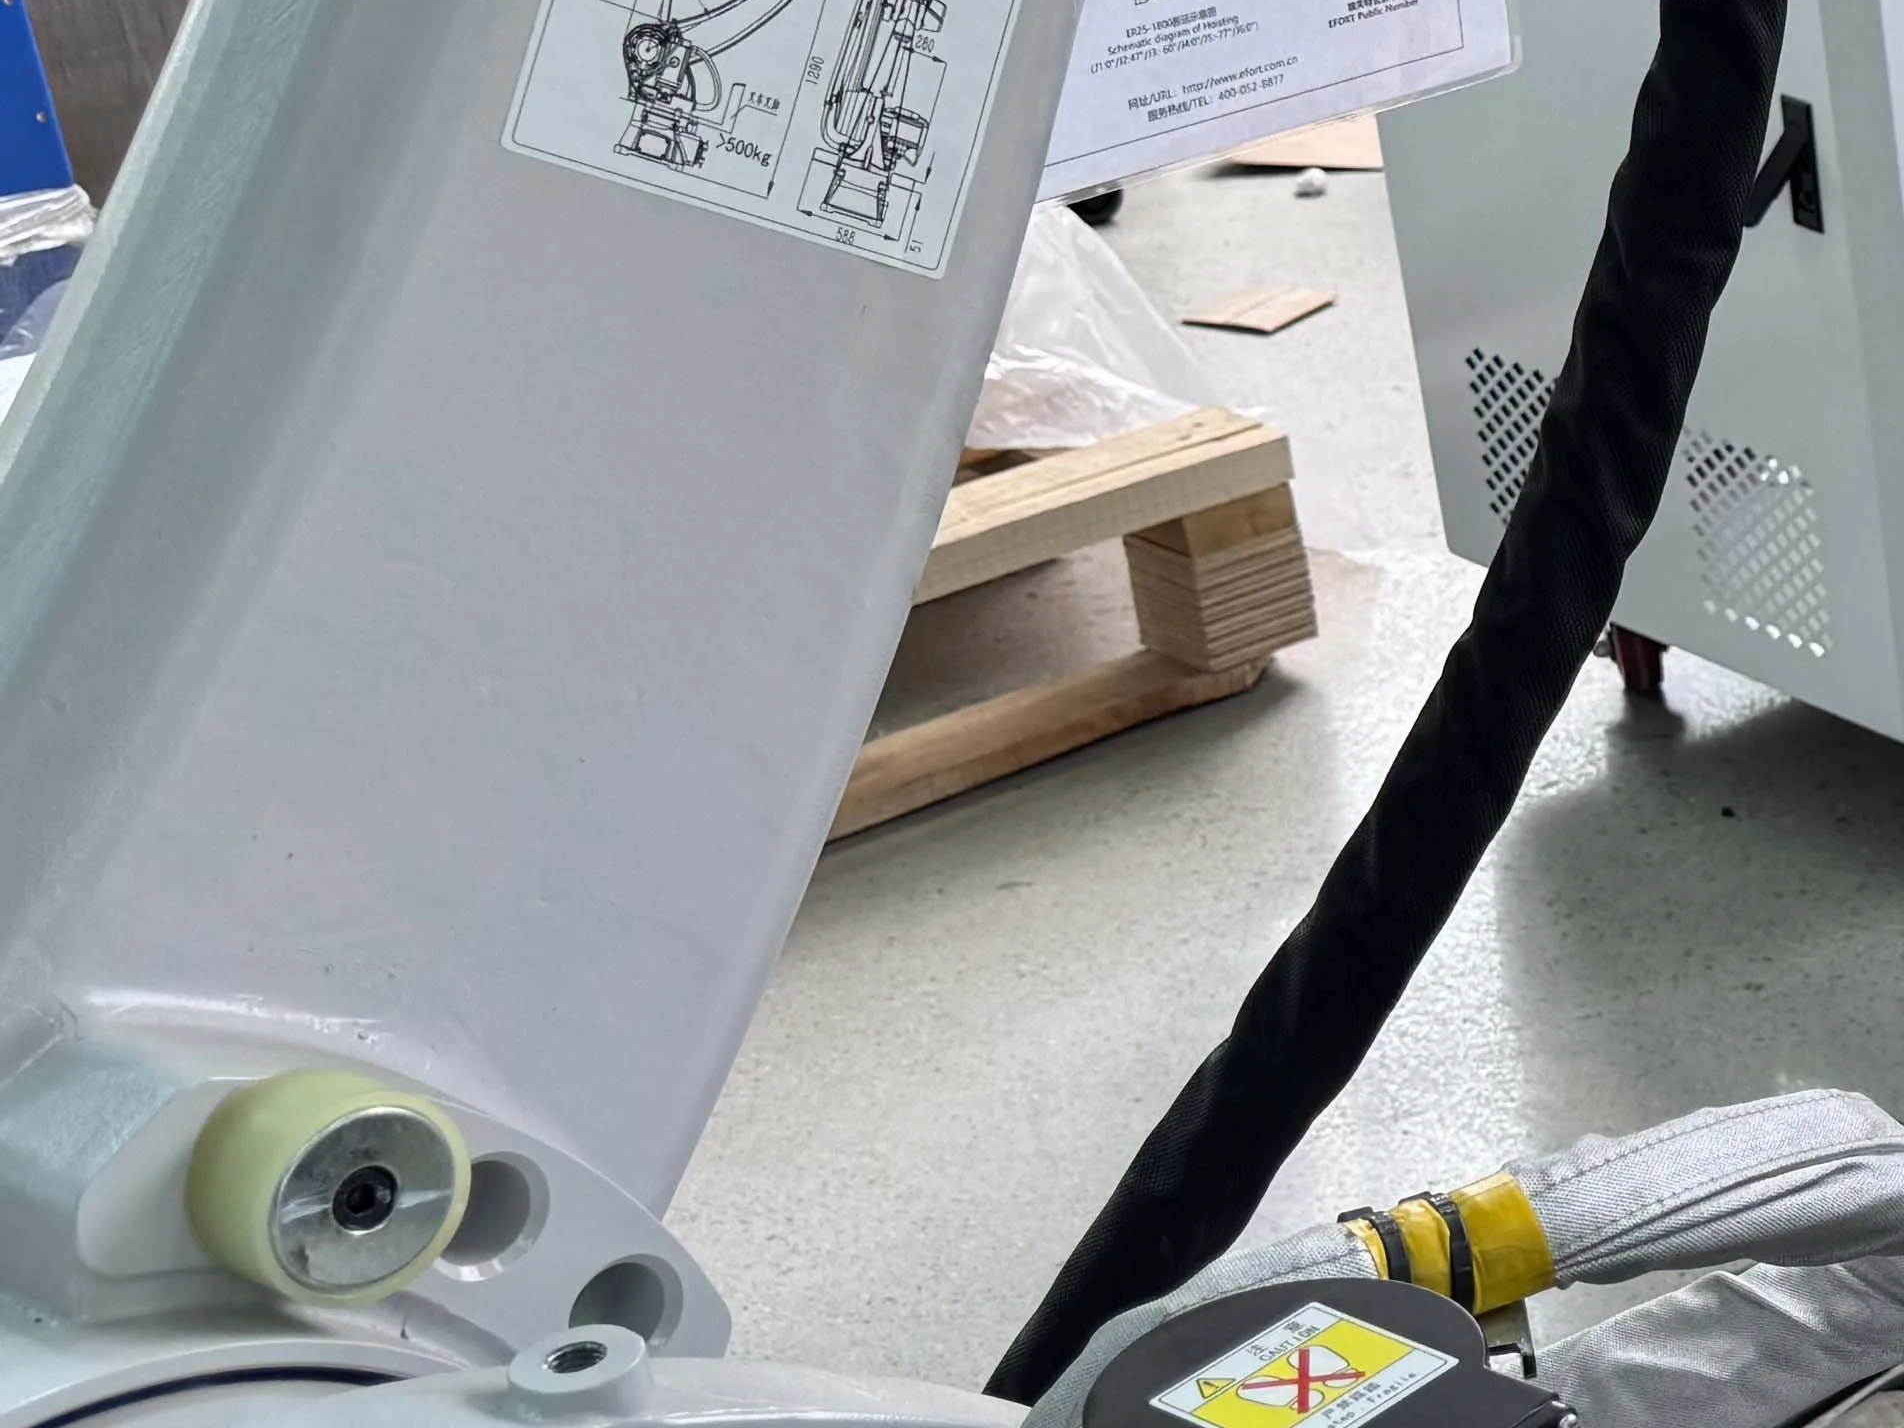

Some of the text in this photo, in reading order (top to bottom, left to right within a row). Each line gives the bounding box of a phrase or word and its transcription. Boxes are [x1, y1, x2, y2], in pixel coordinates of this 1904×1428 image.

[1108, 37, 1152, 55] Schematic
[1155, 28, 1191, 45] diagram
[1192, 25, 1201, 36] of
[806, 56, 824, 85] 1290
[716, 133, 773, 167] >500kg
[1258, 1325, 1321, 1362] CAUTION
